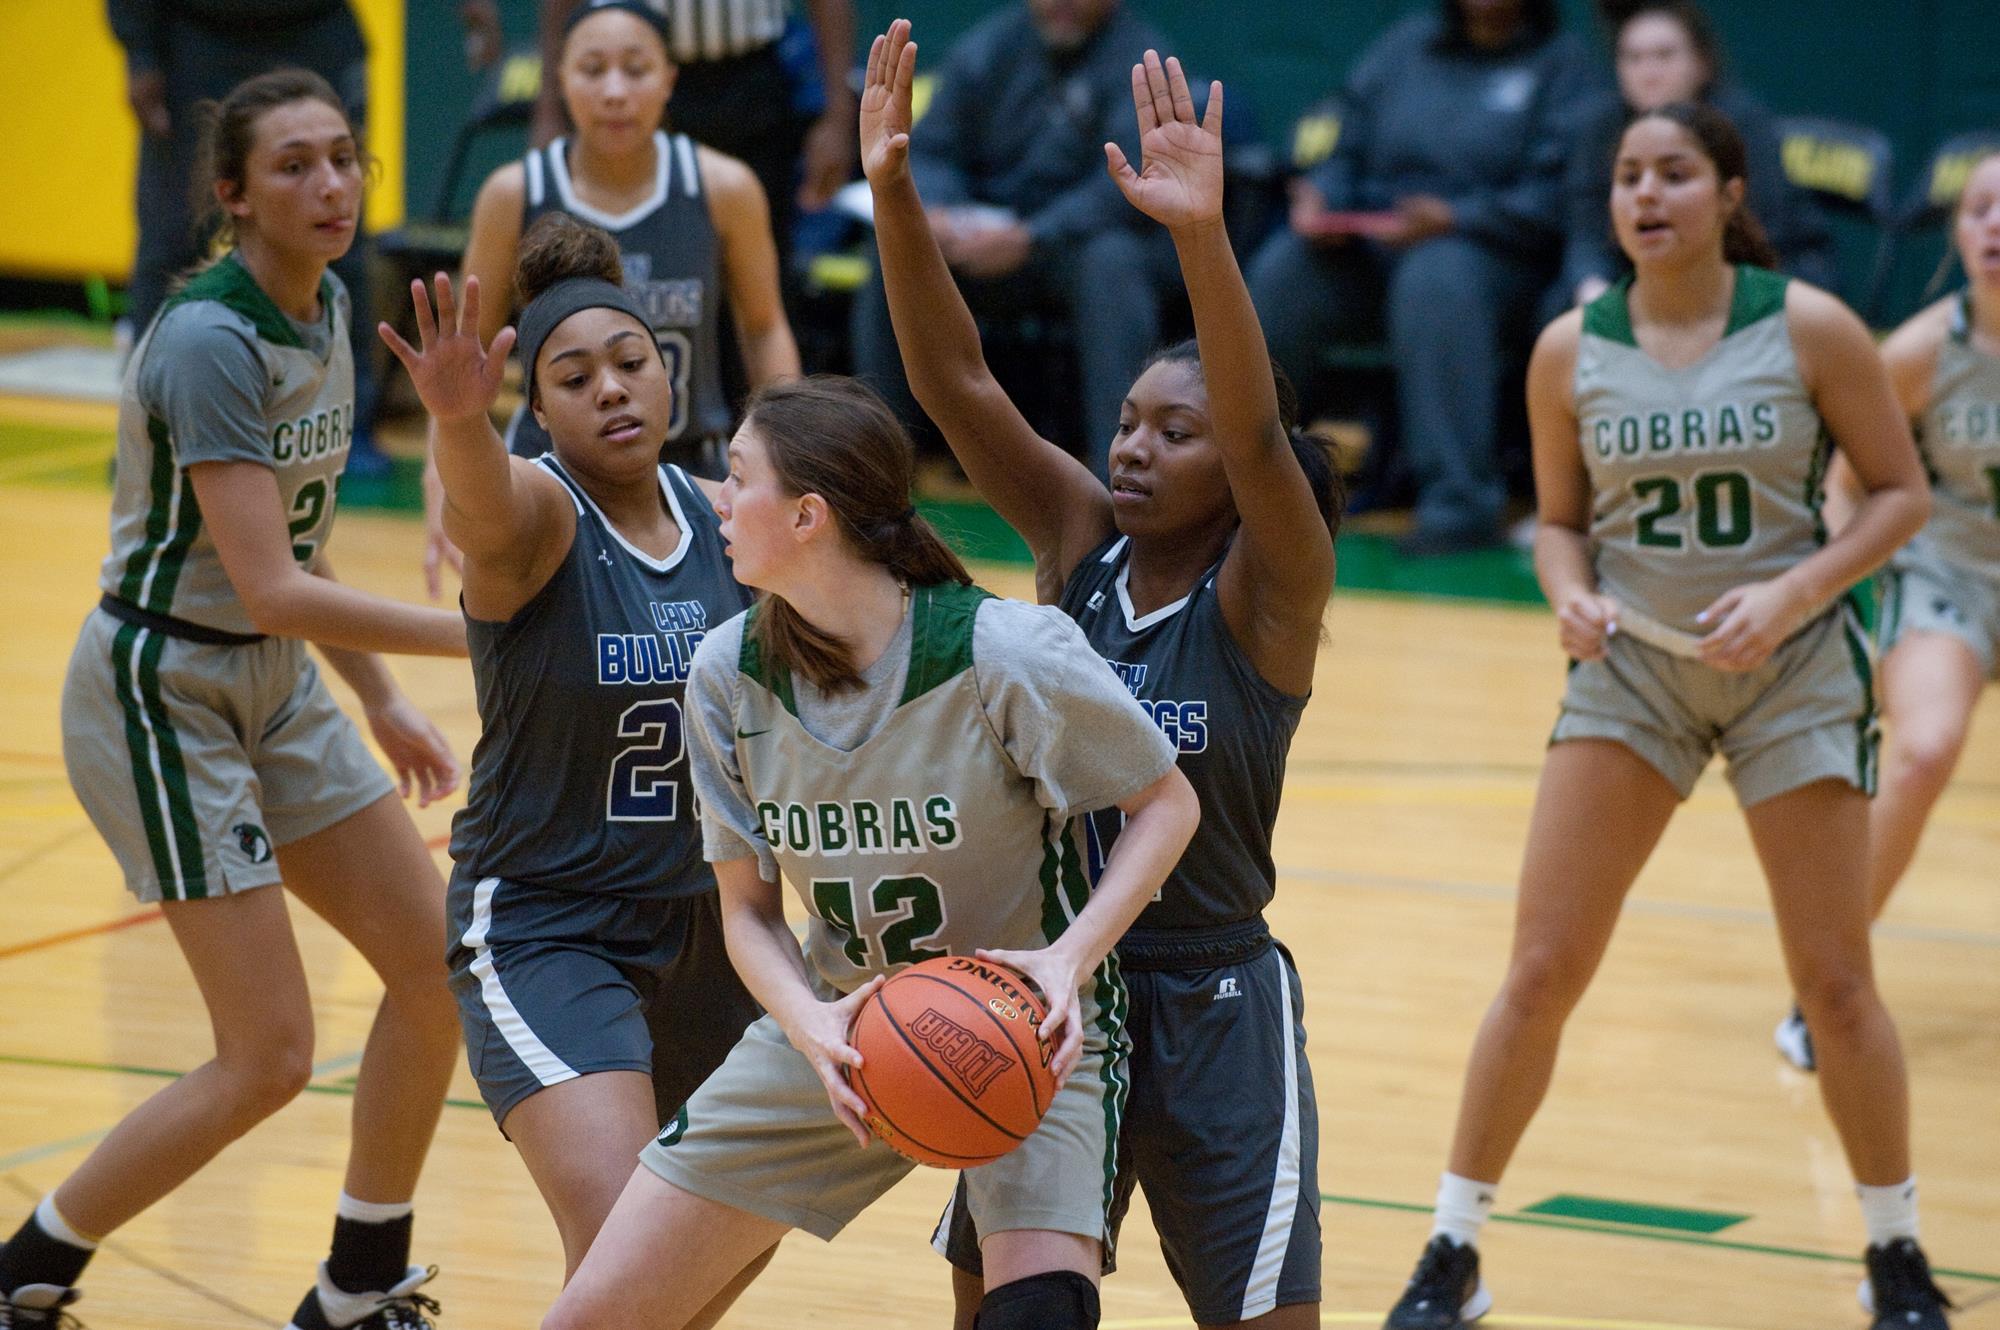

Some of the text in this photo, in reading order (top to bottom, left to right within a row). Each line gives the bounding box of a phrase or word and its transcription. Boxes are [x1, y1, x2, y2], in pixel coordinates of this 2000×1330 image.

[1592, 401, 1778, 460] COBRAS
[1941, 403, 1999, 441] CO
[288, 475, 342, 562] 2
[1629, 469, 1756, 551] 20
[650, 600, 707, 632] LADY
[1106, 660, 1148, 697] DY
[607, 698, 700, 820] 2
[756, 794, 963, 857] COBRAS
[810, 872, 953, 969] 42
[948, 958, 1054, 1069] ALDING
